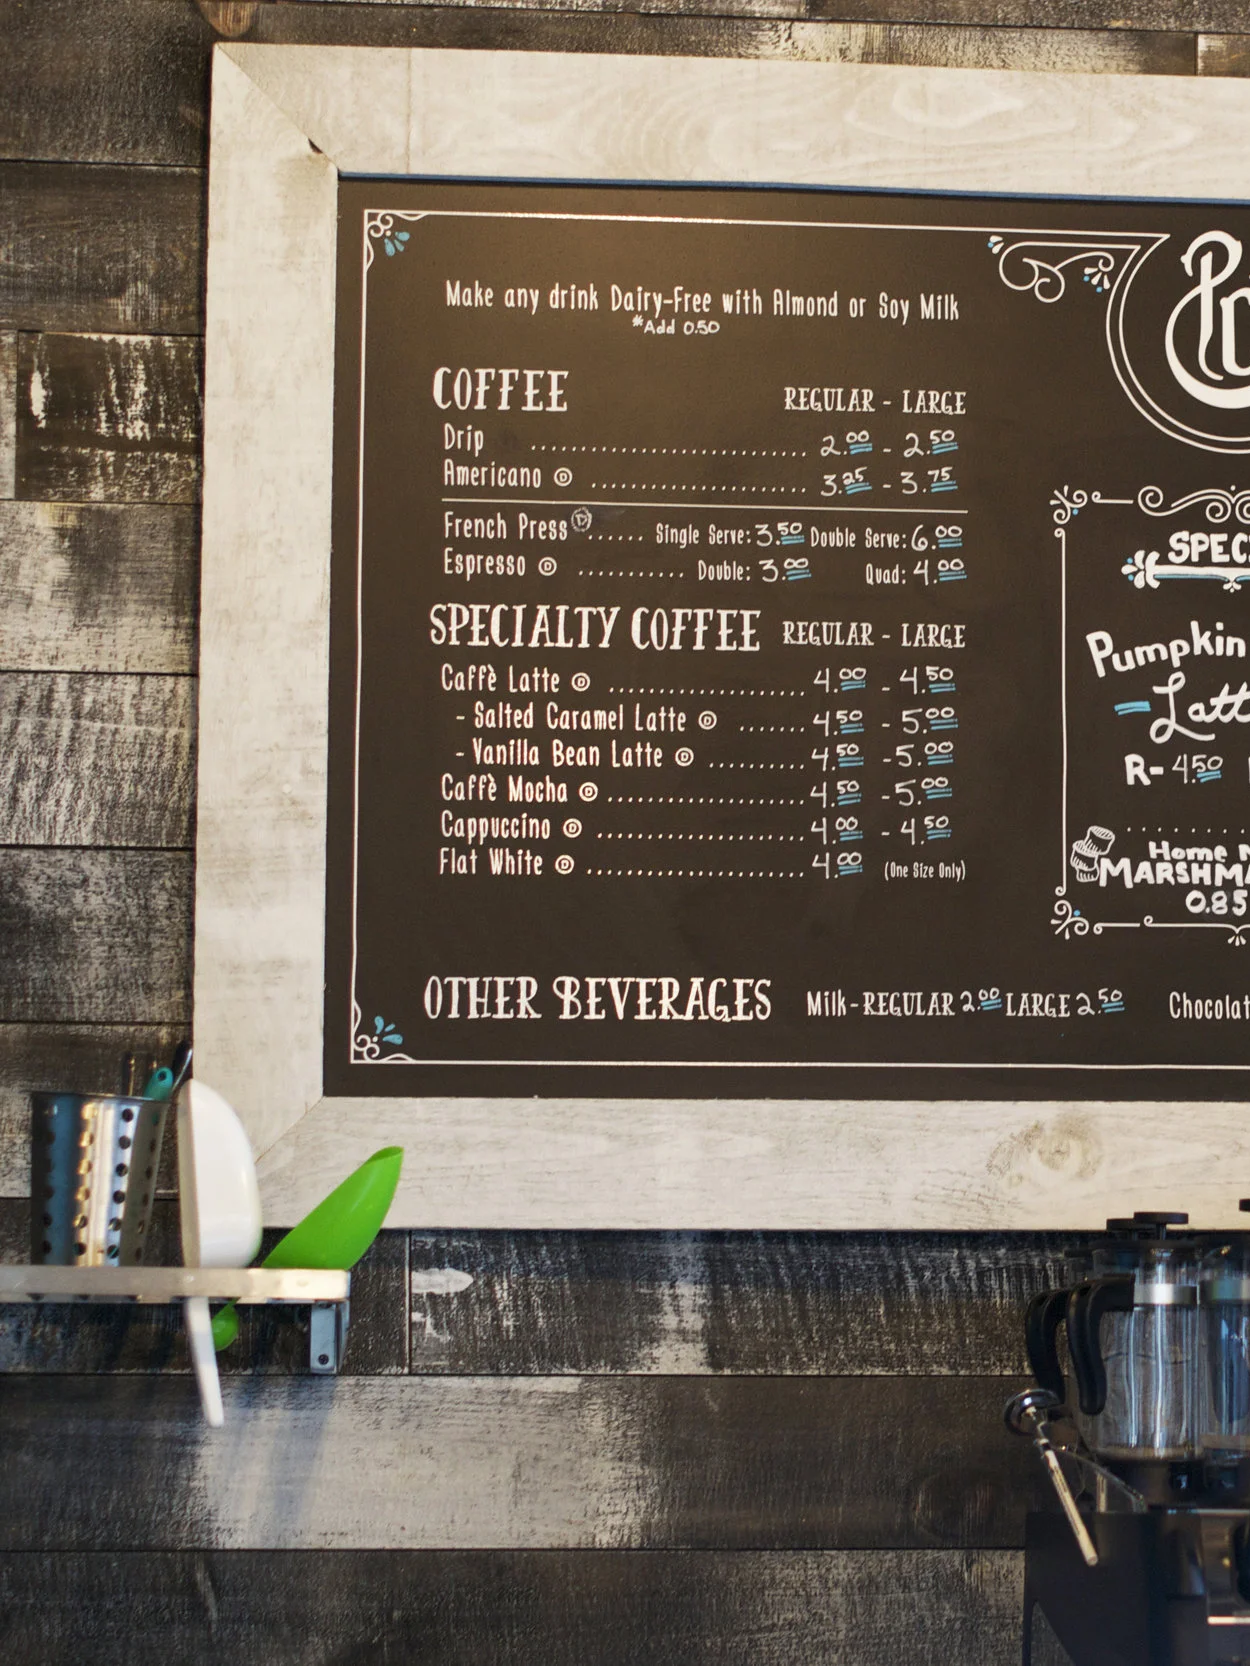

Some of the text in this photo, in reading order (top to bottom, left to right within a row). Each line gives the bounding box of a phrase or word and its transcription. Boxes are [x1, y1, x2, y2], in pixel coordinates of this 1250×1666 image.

[445, 279, 959, 326] Make any drink Dairy-Free with Almond or Soy Milk
[683, 319, 721, 336] 0.50
[432, 366, 569, 412] COFFEE
[783, 386, 967, 416] REGULAR LARGE
[444, 422, 955, 458] Drip 2.00 2.50
[443, 458, 953, 497] Americano 3.25 3.75
[444, 511, 963, 552] French Press Single Serve: 3.50 Double Serve: 6.00
[444, 546, 965, 586] Espresso Double: 3.00 Quad: 4.00
[429, 602, 762, 652] SPECIALTY COFFEE
[782, 620, 966, 649] REGULAR LARGE
[1085, 620, 1247, 683] Pumpkin
[441, 662, 954, 695] Caffè Latte 4.00 4.50
[474, 700, 955, 737] Salted Caramel Latte 4.50 5.00
[472, 737, 954, 772] Vanilla Bean Latte 4.50 5.00
[1171, 753, 1224, 785] 4.50
[441, 772, 949, 809] Caffè Mocha 4.50 5.00
[441, 809, 949, 846] Cappuccino 4.00 4.50
[439, 847, 966, 883] Flat White 4.00 (One Size Only)
[1148, 840, 1228, 863] Home
[1185, 889, 1248, 917] 0.85
[423, 975, 772, 1023] OTHER BEVERAGES
[959, 987, 1000, 1012] 2.00
[1005, 992, 1071, 1018] LARGE
[1075, 987, 1123, 1016] 2.50
